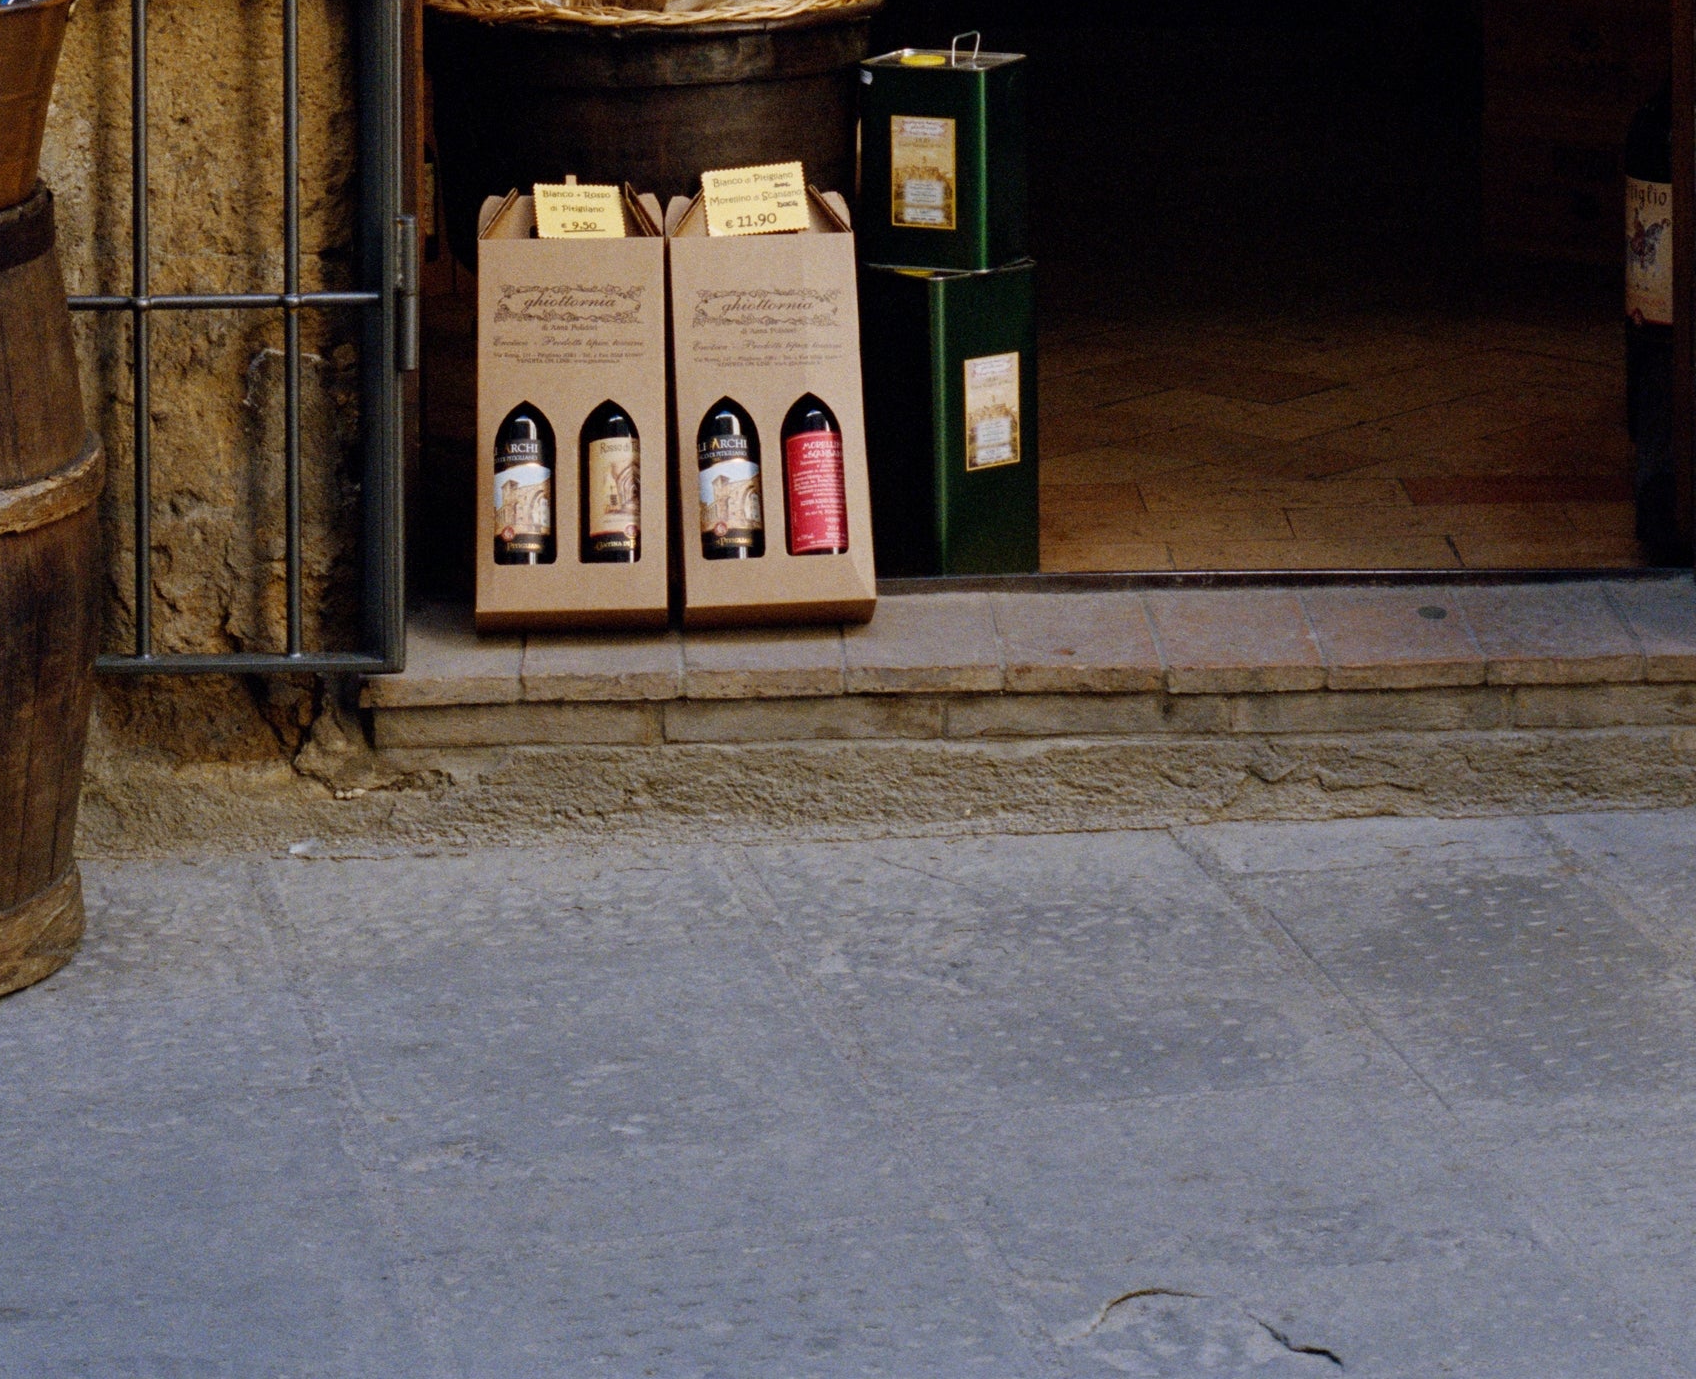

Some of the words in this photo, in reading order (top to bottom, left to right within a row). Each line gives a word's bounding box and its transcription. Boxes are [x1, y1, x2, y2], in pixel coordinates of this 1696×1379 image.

[712, 177, 743, 188] Bianco
[753, 171, 794, 183] Pitigliano
[542, 190, 574, 198] Bianco
[584, 191, 611, 199] Rosso
[709, 194, 751, 206] Morellino
[762, 188, 802, 201] Scansano
[562, 205, 605, 214] Pitigliano
[725, 220, 734, 228] €
[736, 213, 777, 228] 11,90
[521, 292, 616, 314] ghiottornia
[722, 297, 813, 315] ghiottornia
[712, 438, 747, 449] ARCHI
